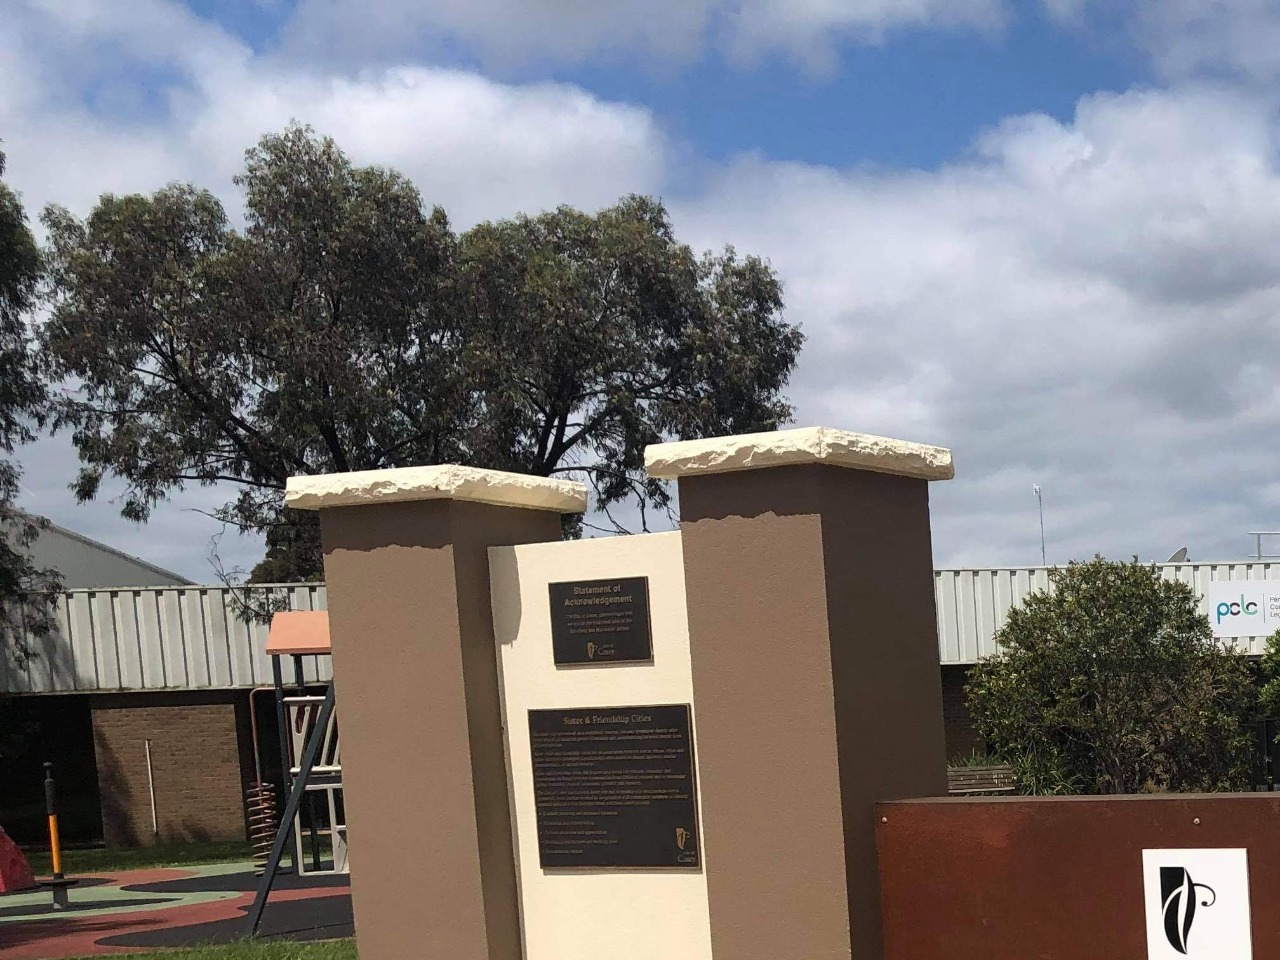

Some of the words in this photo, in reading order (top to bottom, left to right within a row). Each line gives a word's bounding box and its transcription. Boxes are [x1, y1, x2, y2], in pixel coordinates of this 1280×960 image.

[573, 586, 612, 595] Statement
[613, 584, 621, 592] of
[564, 596, 632, 606] Acknowledgement
[1216, 594, 1258, 624] pclc
[563, 716, 584, 725] Sister
[592, 715, 630, 724] Friendship
